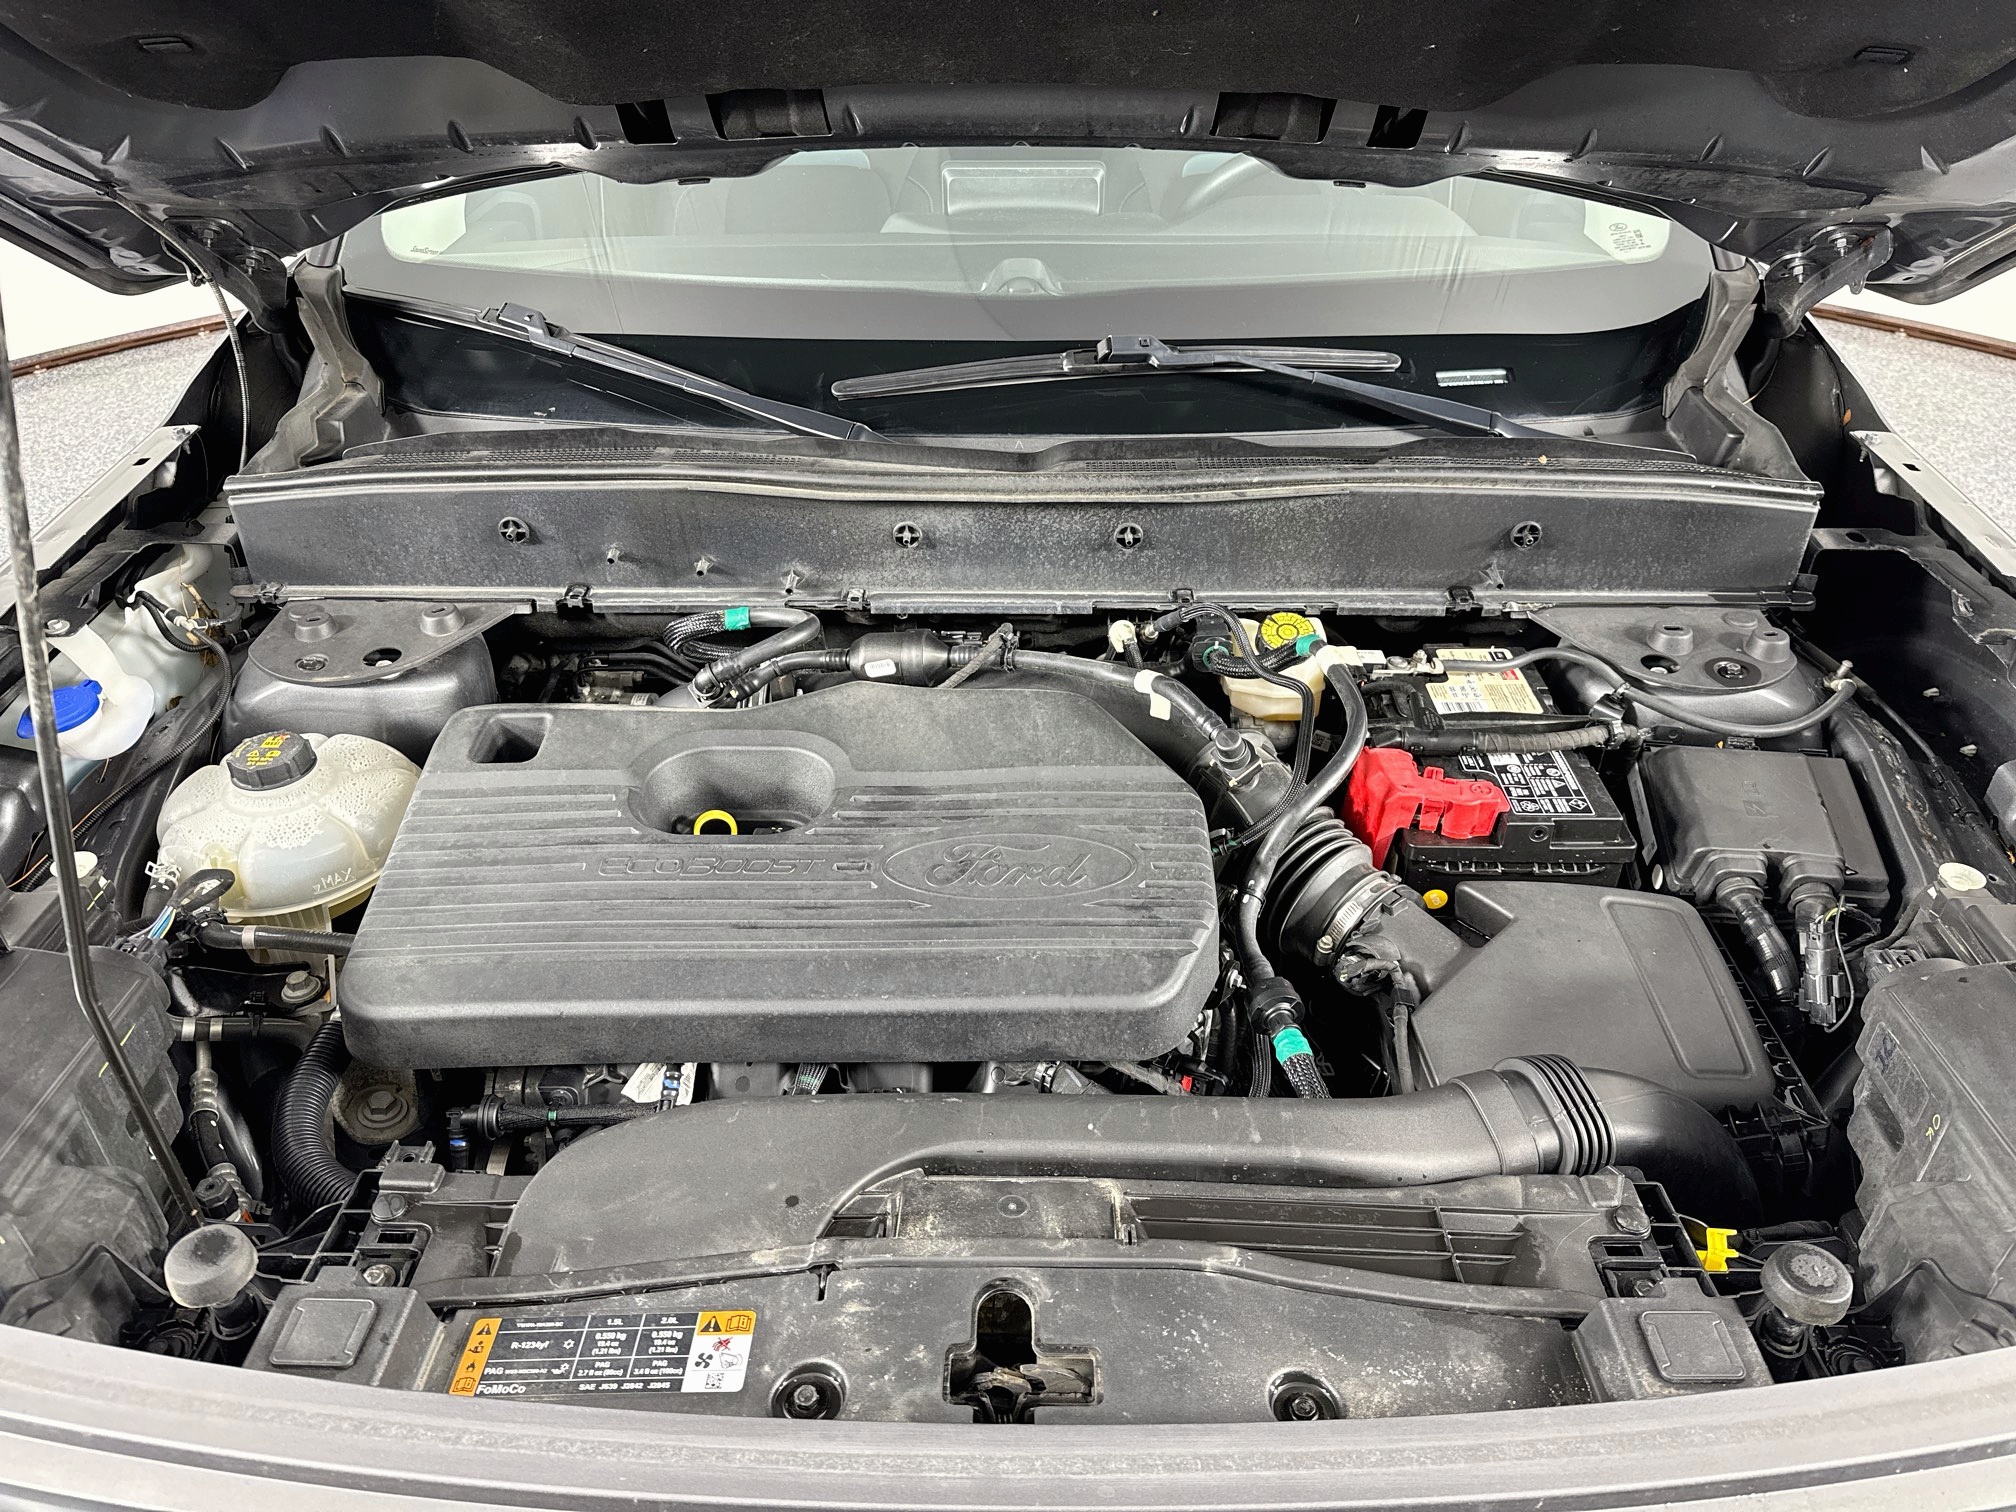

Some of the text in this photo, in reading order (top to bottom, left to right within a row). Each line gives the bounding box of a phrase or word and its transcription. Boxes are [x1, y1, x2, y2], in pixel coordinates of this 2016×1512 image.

[925, 843, 1093, 888] Ford
[320, 867, 355, 889] MAX
[511, 1341, 550, 1350] R-1234yf
[476, 1384, 527, 1395] FoMoCo
